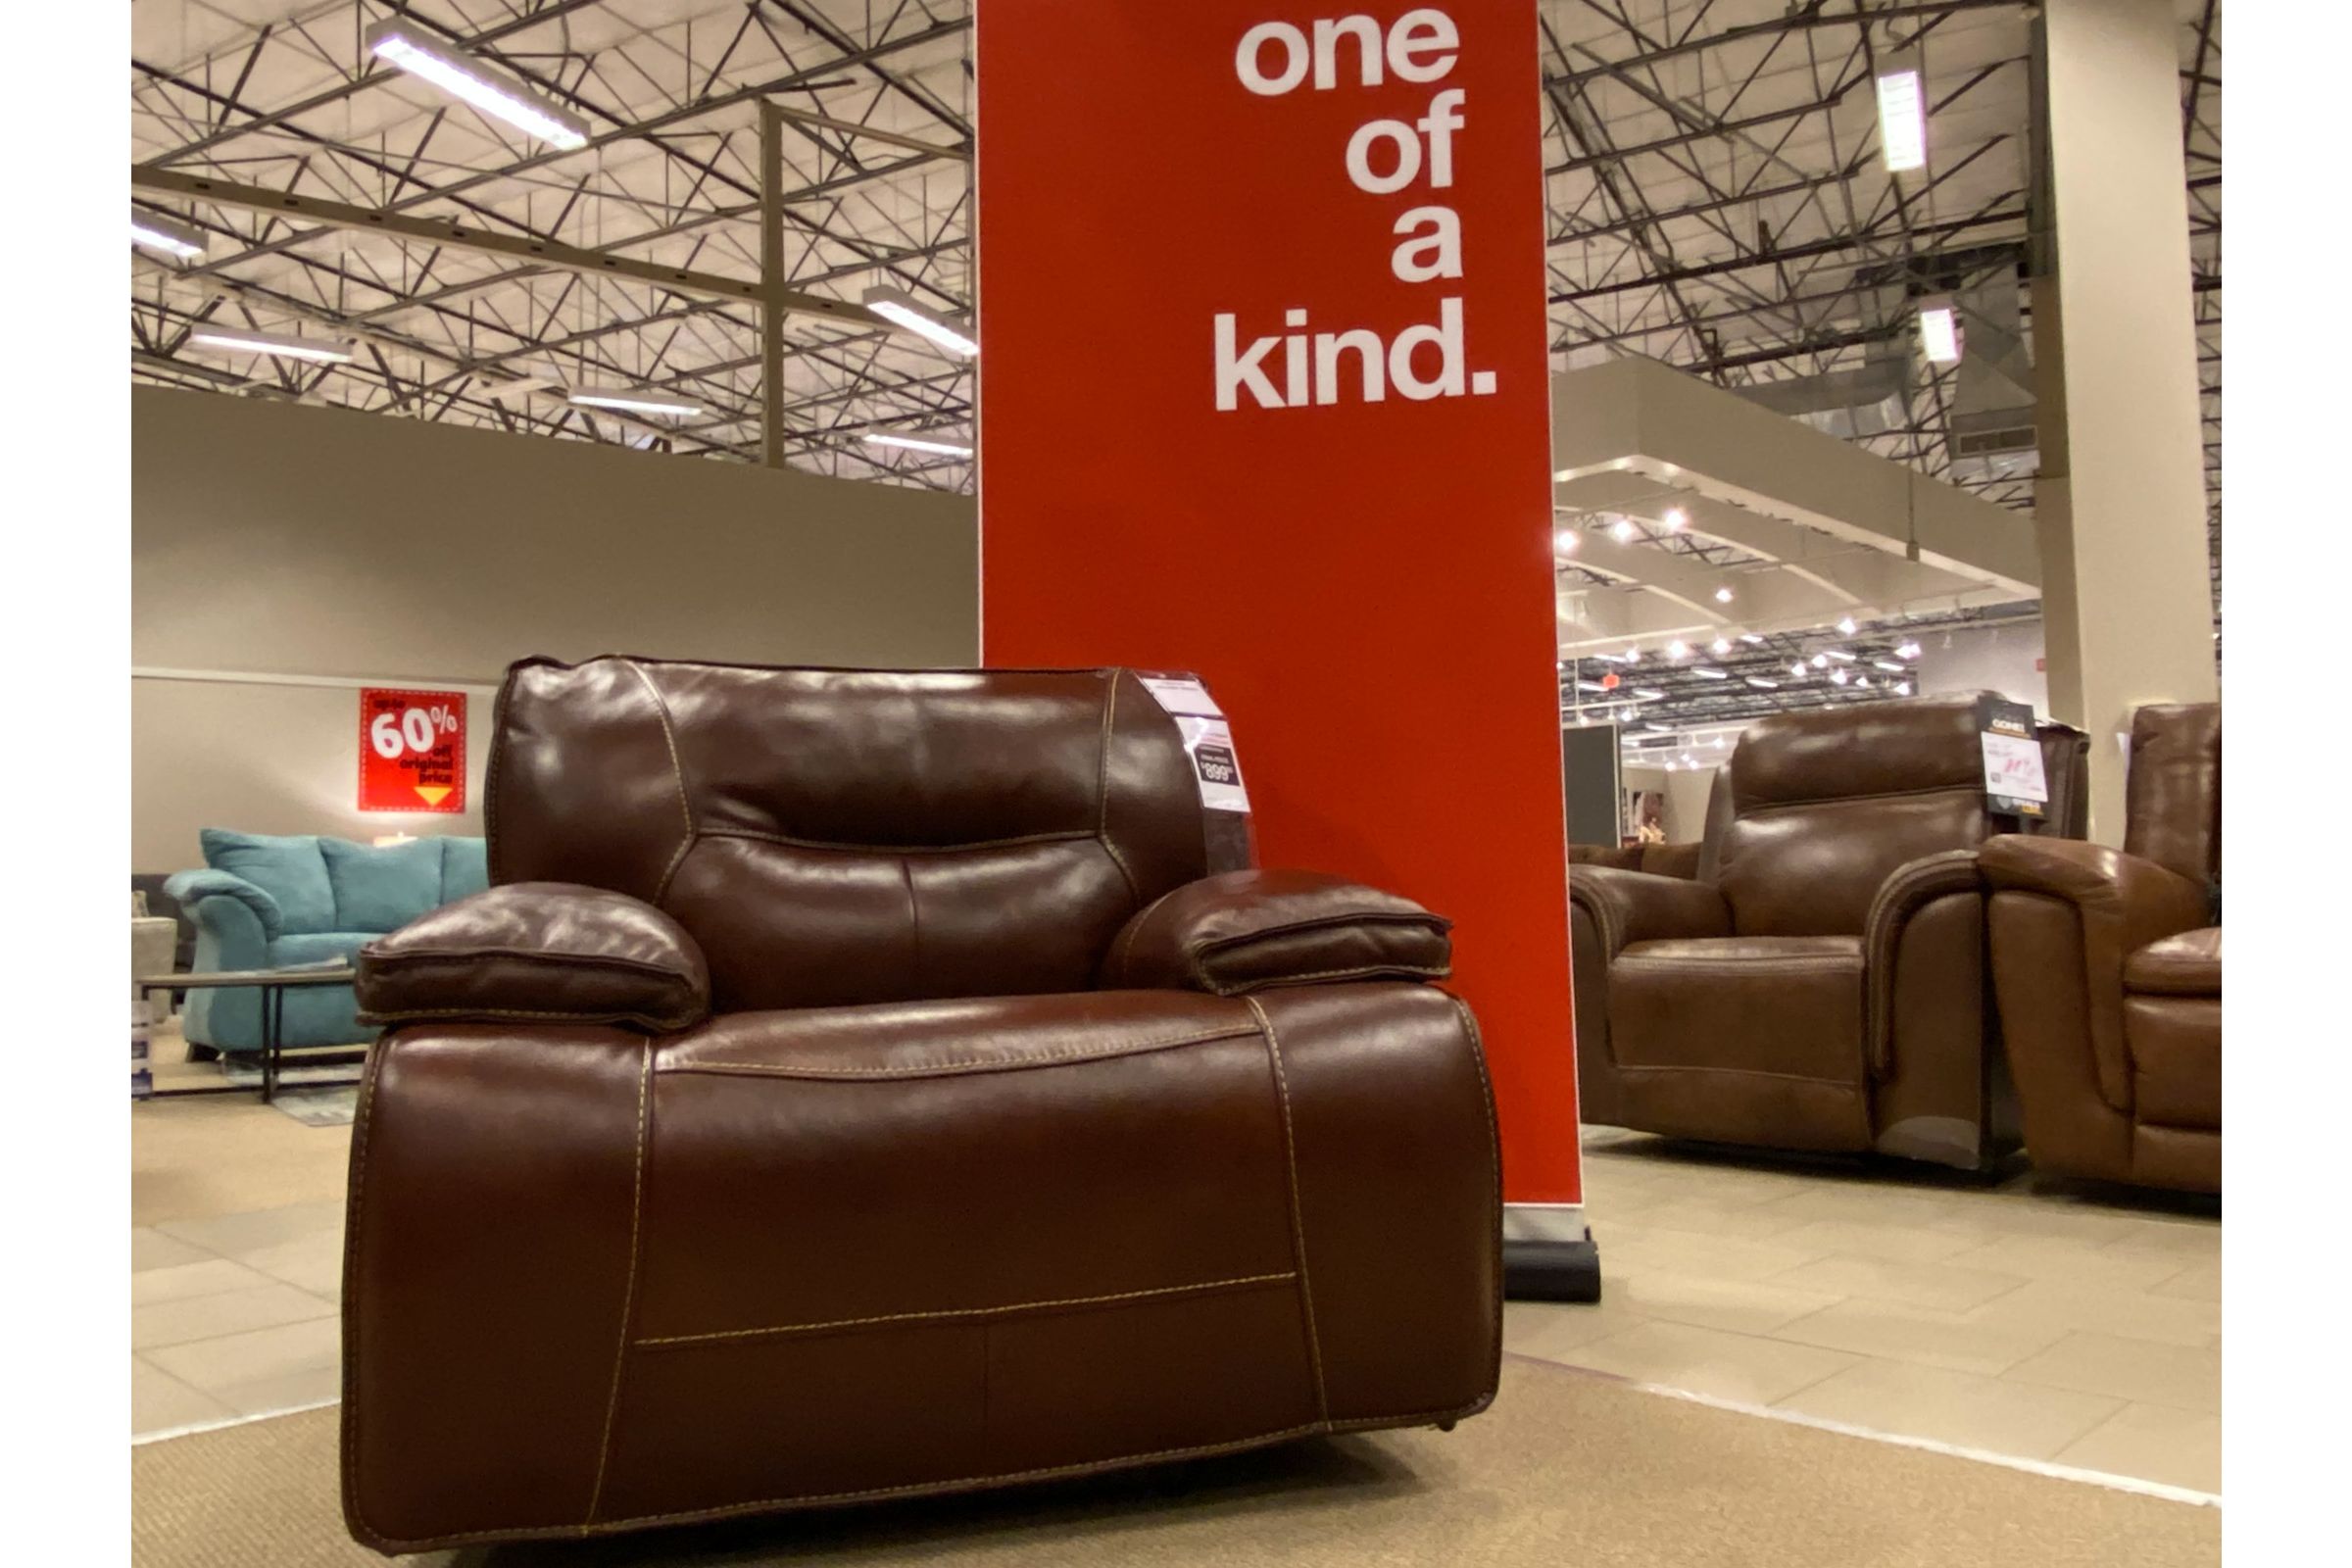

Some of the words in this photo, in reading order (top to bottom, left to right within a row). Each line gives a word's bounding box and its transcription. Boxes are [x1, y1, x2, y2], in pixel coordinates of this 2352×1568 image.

[1235, 8, 1460, 96] one
[1346, 88, 1466, 195] of
[1391, 205, 1464, 283] a
[1214, 297, 1497, 412] kind.
[370, 704, 459, 759] 60%
[418, 770, 453, 785] price
